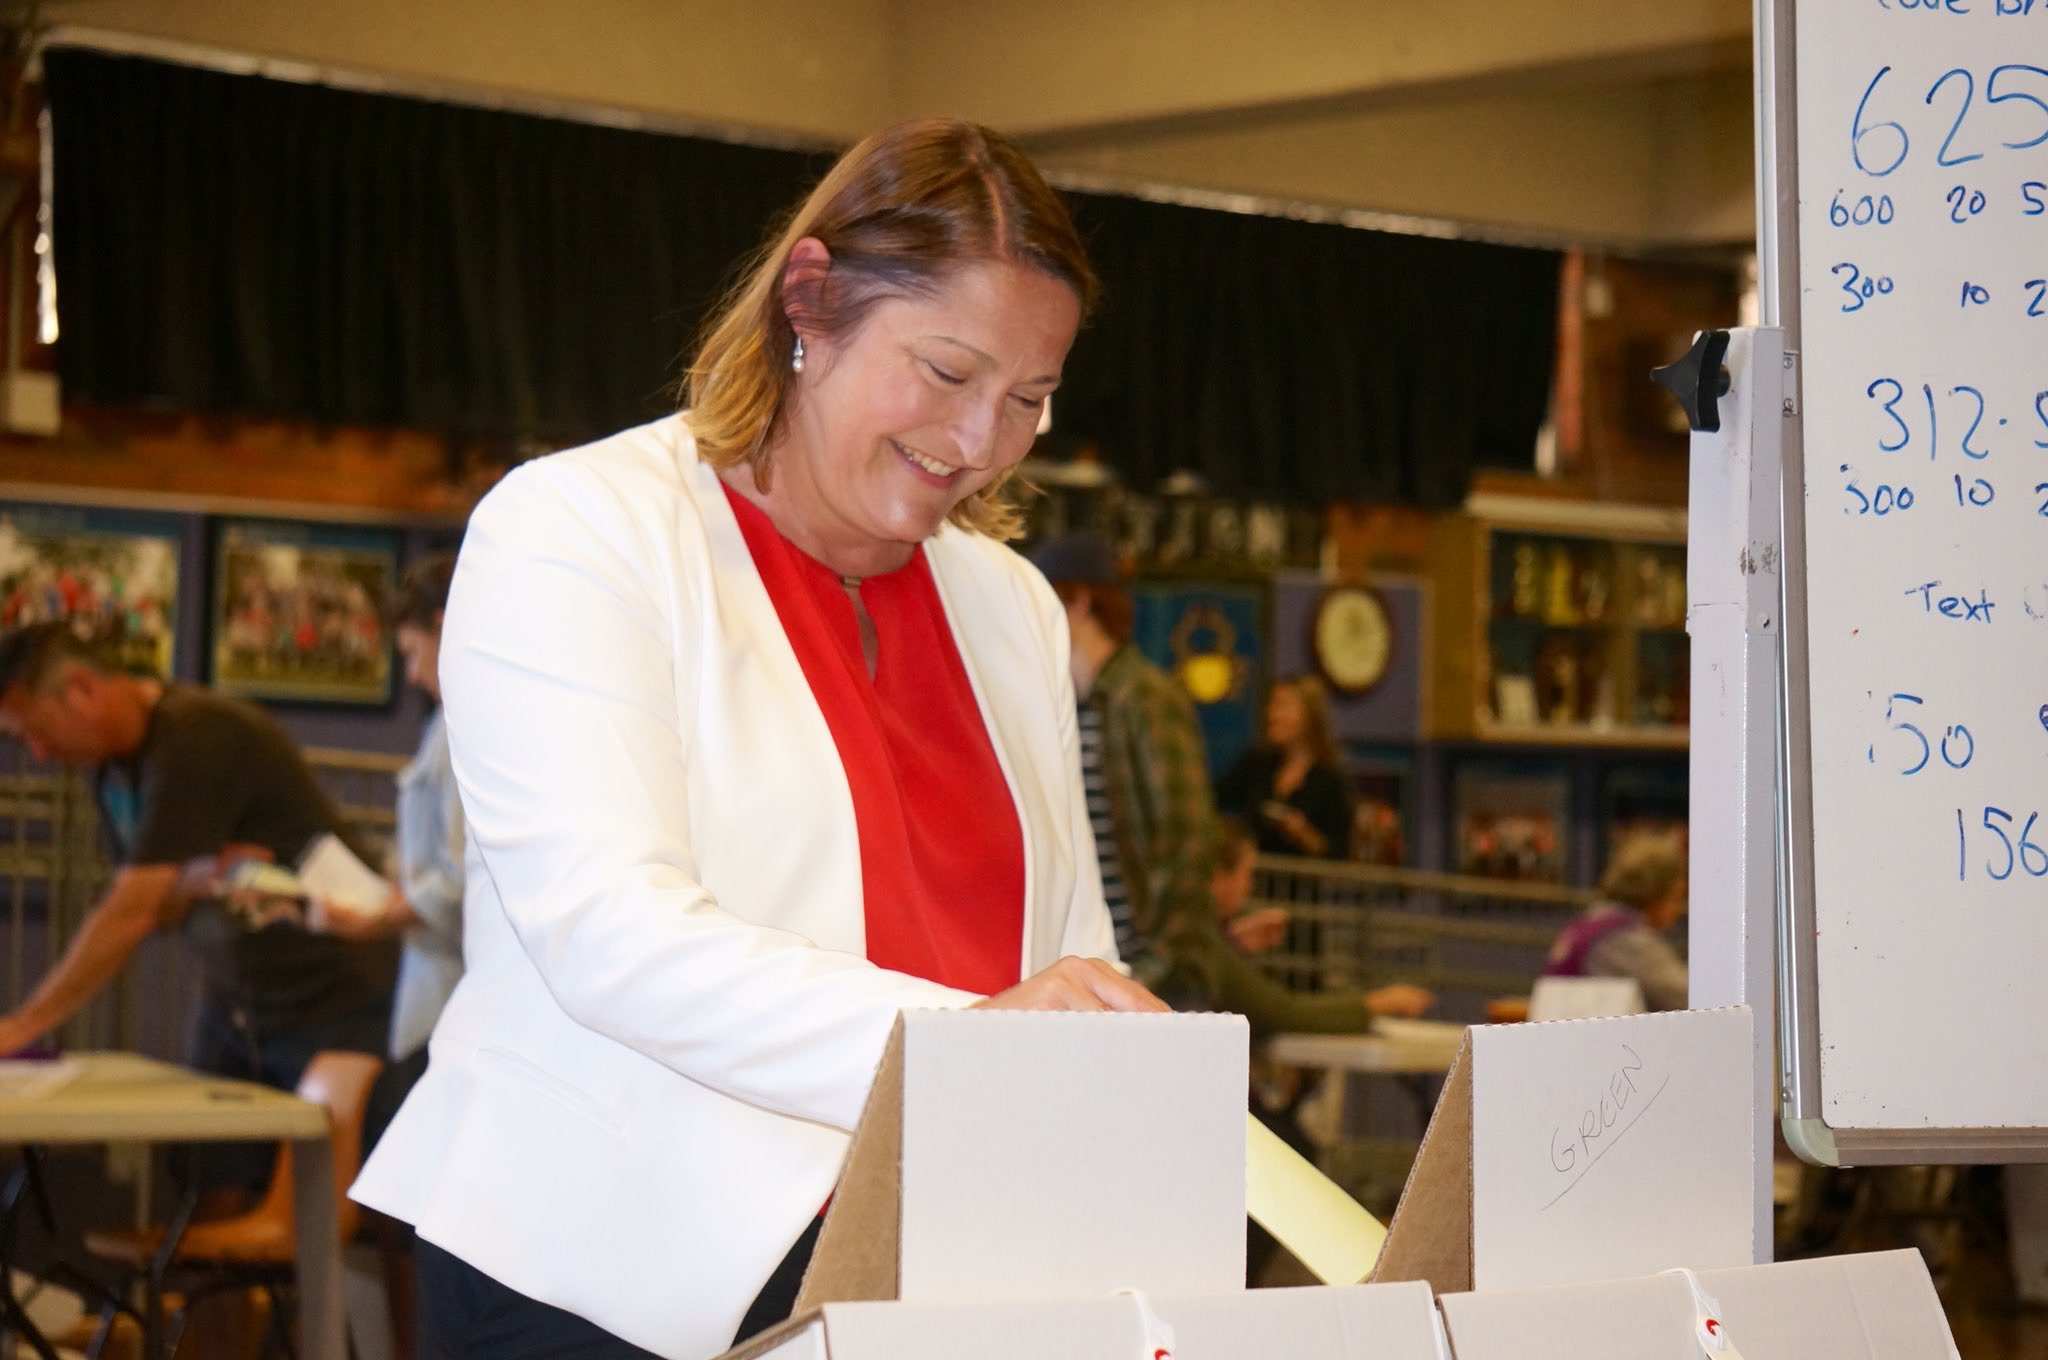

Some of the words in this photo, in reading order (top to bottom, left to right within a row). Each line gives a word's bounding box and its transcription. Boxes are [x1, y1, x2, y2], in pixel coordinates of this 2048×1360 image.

[1852, 64, 2048, 177] 625
[1830, 188, 1894, 227] 600
[1946, 185, 1986, 224] 20
[1831, 262, 1894, 312] 300
[1961, 281, 1990, 308] 10
[1955, 473, 1995, 506] 10
[1904, 580, 1995, 623] Text
[1957, 806, 2048, 882] 156
[1551, 1043, 1643, 1173] GREEN
